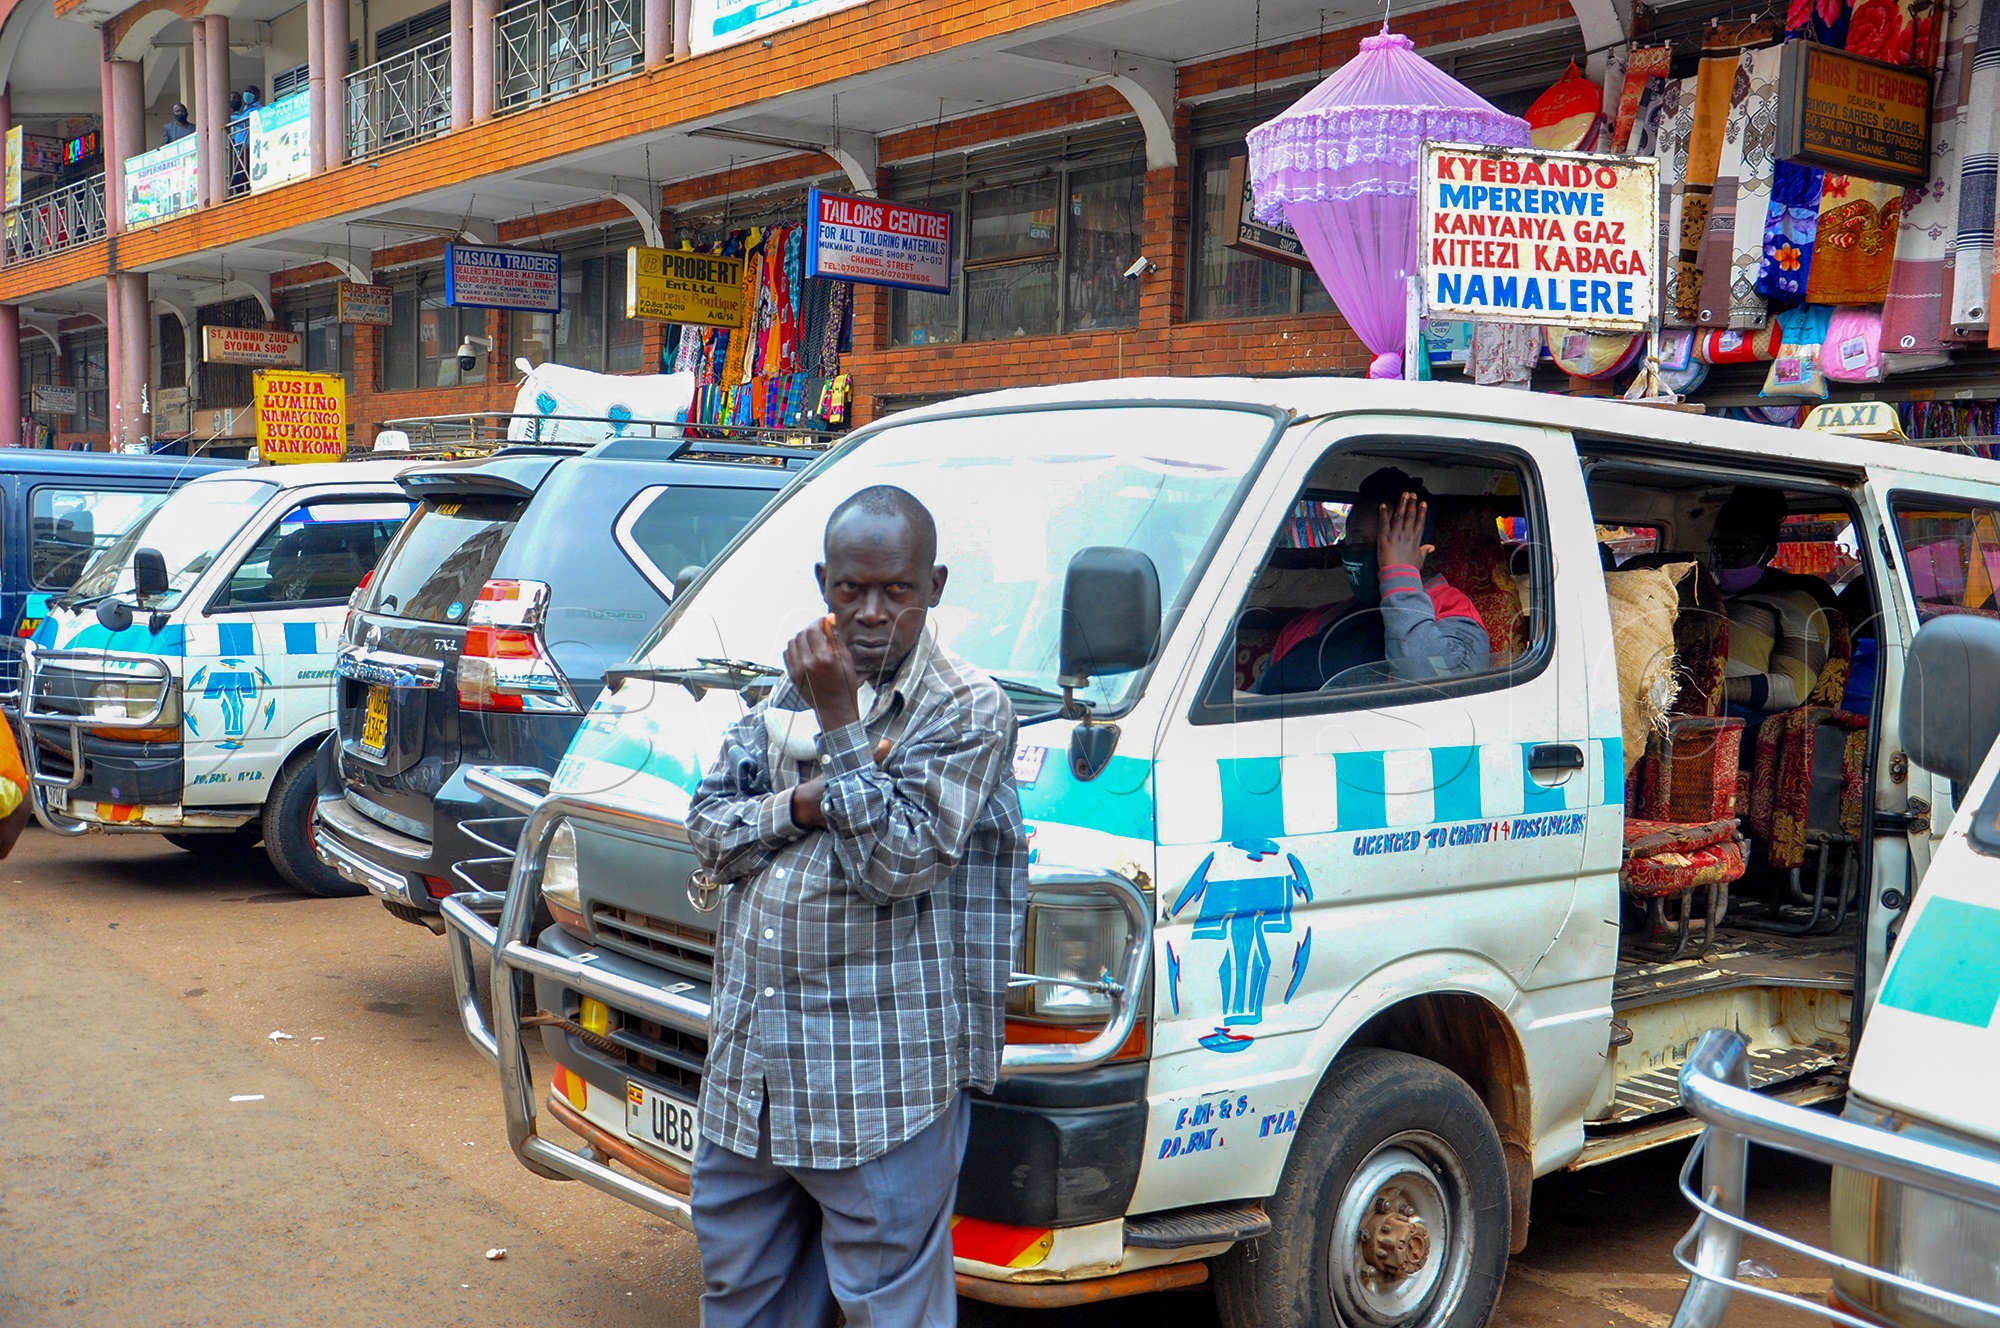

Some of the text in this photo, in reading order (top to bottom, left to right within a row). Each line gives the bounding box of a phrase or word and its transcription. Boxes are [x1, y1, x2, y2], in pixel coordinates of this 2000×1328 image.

[1856, 67, 1928, 110] ENTERPRISES
[1847, 94, 1876, 110] DEALERS
[1842, 105, 1879, 127] SAREES
[1820, 115, 1835, 131] BOX
[1854, 126, 1870, 140] KLA
[1803, 129, 1826, 143] SHOP
[1856, 141, 1889, 158] CHANNEL
[137, 158, 181, 179] SUPERMARKET
[1437, 156, 1619, 190] KYEBANDO
[1439, 183, 1605, 217] MPERERWE
[888, 209, 946, 239] CENTRE
[1433, 212, 1627, 246] KANYANYA GAZ
[818, 240, 854, 253] MUKWANO
[855, 246, 884, 258] ARCADE
[885, 250, 905, 260] SHOP
[819, 224, 946, 256] FOR ALL TAILORING MATERIALS
[1279, 237, 1298, 252] SHOP
[454, 249, 558, 273] MASAKA TRADERS
[850, 254, 915, 272] CHANNEL STREET
[1431, 238, 1648, 277] KITEEZI KABAGA
[455, 265, 482, 276] DEALERS
[491, 268, 519, 279] TAILORS
[521, 270, 557, 281] MATERIALS
[662, 254, 740, 286] PROBERT
[455, 288, 481, 296] MUKWANO
[483, 290, 505, 298] ARCADE
[499, 285, 529, 294] CHANNEL
[532, 288, 557, 296] STREET
[1436, 272, 1634, 316] NAMALERE
[639, 306, 673, 317] KAMPALA
[692, 292, 739, 313] Boutique
[210, 328, 300, 345] ST. ANTONIO ZUULA
[223, 340, 289, 354] BYONNA SHOP
[266, 380, 326, 396] BUSIA
[260, 409, 342, 426] NAMAYINGO
[1816, 404, 1880, 428] TAXI
[265, 423, 341, 441] BUKOOLI
[263, 438, 344, 456] NANKOMA
[1352, 830, 1421, 857] LICENCED
[1449, 821, 1493, 847] CARRY
[1493, 819, 1511, 842] 14
[1510, 813, 1586, 841] PASSENGERS
[1218, 1097, 1233, 1120] &
[651, 1095, 694, 1153] UBB
